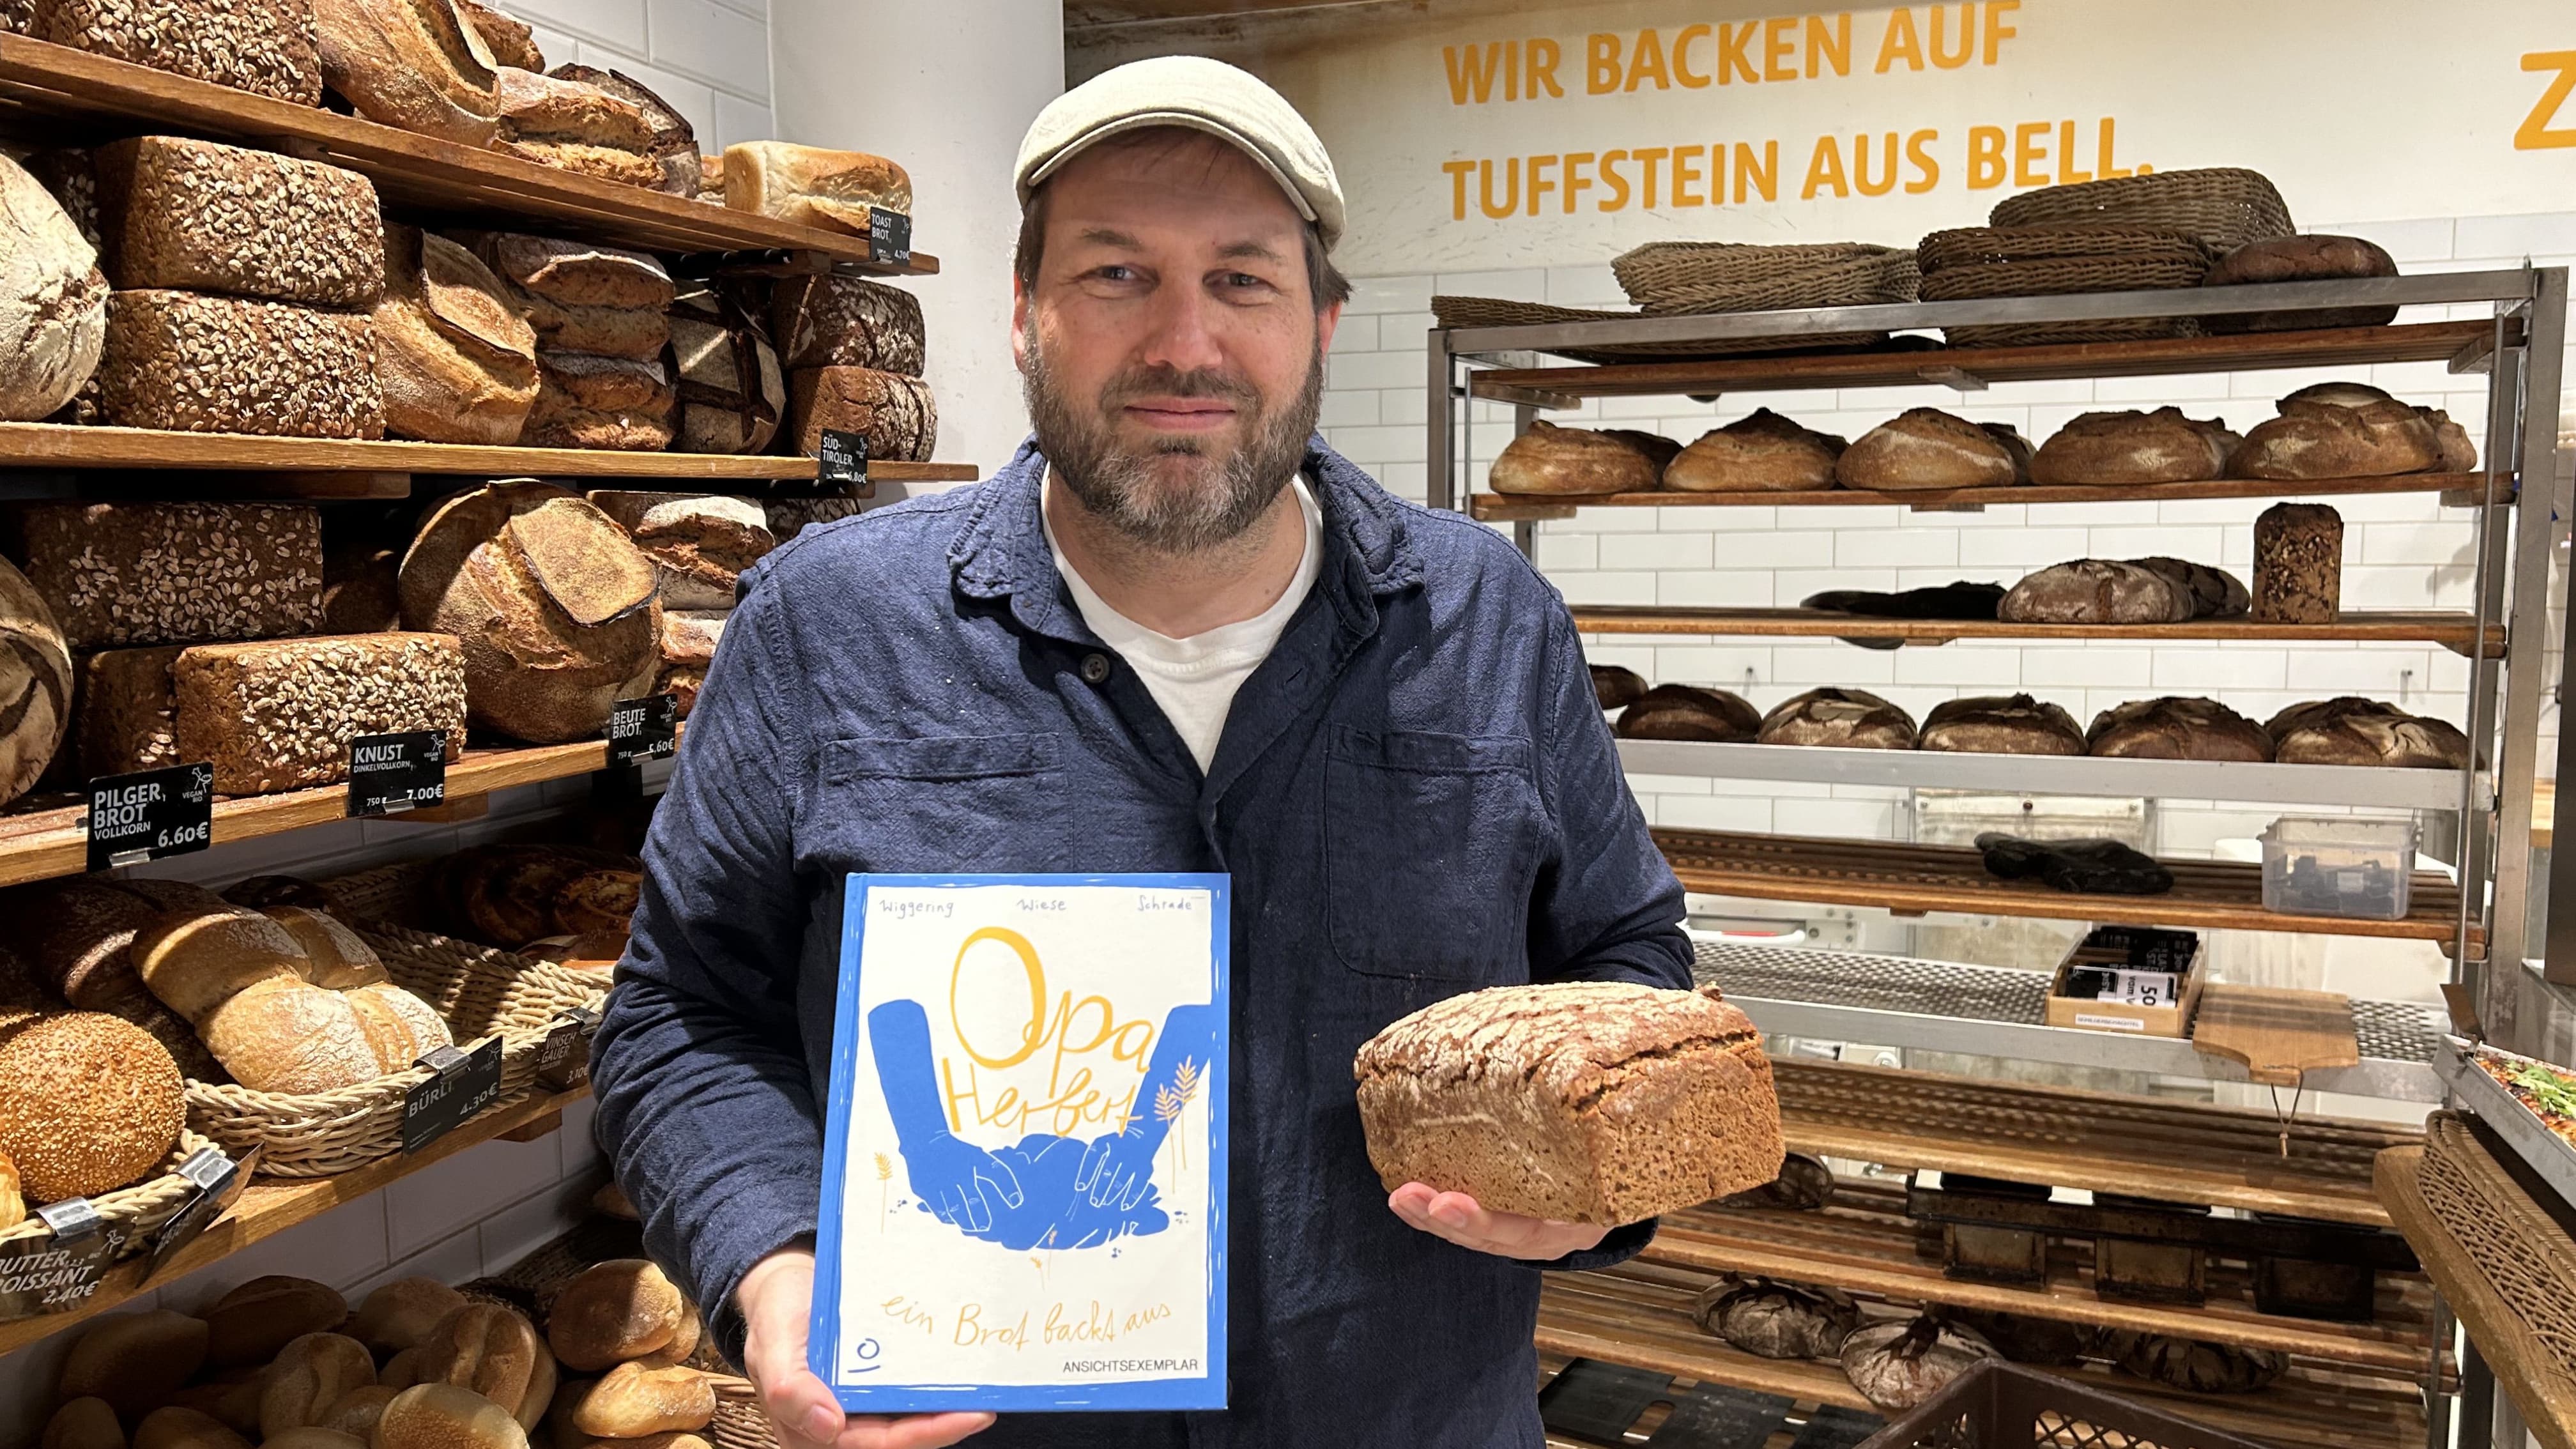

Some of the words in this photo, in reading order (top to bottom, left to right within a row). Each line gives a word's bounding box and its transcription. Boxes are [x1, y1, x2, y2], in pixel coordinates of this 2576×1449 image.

[1443, 38, 1564, 105] WIR
[1586, 14, 1852, 95] BACKEN
[1874, 0, 2021, 73] AUF
[1443, 140, 1779, 221] TUFFSTEIN
[1800, 128, 1940, 199] AUS
[1966, 117, 2154, 190] BELL.
[871, 213, 892, 229] TOAST
[871, 227, 889, 241] BROT
[823, 434, 841, 450] SÜD-
[823, 449, 853, 466] TIROLER
[613, 708, 646, 726] BEUTE
[613, 722, 641, 739] BROT
[355, 744, 404, 764] KNUST
[95, 783, 160, 811] PILGER
[182, 790, 203, 799] VEGAN
[406, 783, 444, 800] 7.00€
[367, 797, 380, 807] 750
[94, 803, 147, 830] BROT
[95, 821, 151, 841] VOLLKORN
[158, 822, 209, 848] 6.60€
[880, 898, 954, 918] Wiggering
[1016, 898, 1067, 912] Wiese
[1137, 896, 1193, 912] Schrade
[950, 926, 1155, 1100] Opa
[546, 1032, 578, 1051] VINSCH
[541, 1045, 570, 1064] GAUER
[408, 1081, 452, 1118] BÜRLI
[459, 1082, 498, 1116] 4.30€
[942, 1057, 1144, 1138] Herbert
[0, 1265, 95, 1294] OISSANT
[42, 1280, 100, 1305] 2,40€
[880, 1295, 933, 1335] ein
[953, 1303, 1031, 1352] Brot
[1043, 1300, 1117, 1346] backt
[1122, 1303, 1173, 1336] aus
[1062, 1358, 1199, 1374] ANSICHTSEXEMPLAR
